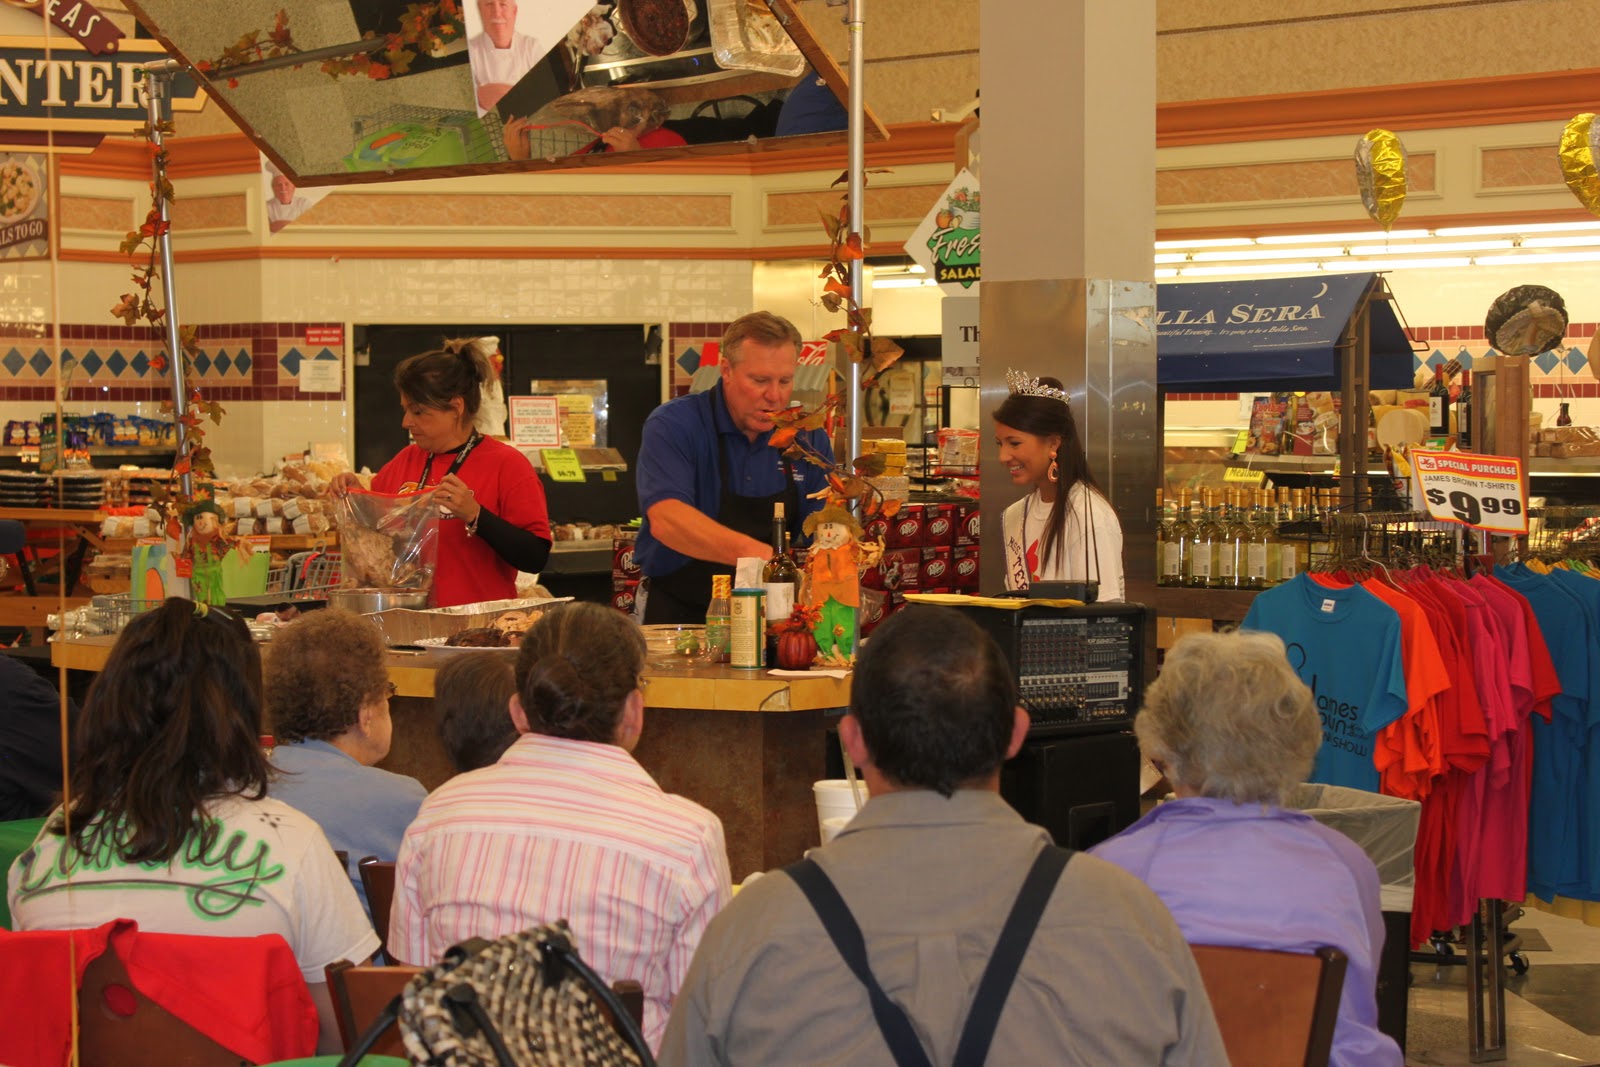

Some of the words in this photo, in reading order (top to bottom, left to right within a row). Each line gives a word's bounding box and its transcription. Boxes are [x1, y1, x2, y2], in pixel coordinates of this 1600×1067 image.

[0, 227, 14, 245] LS
[15, 223, 28, 240] TO
[29, 220, 43, 236] GO
[931, 227, 980, 264] Fres
[1157, 309, 1217, 325] LLA
[1225, 303, 1324, 324] SERA
[1268, 325, 1289, 333] Bella
[1437, 459, 1470, 471] SPECIAL
[1471, 464, 1517, 476] PURCHASE
[1424, 475, 1451, 483] JAMES
[1452, 476, 1478, 488] BROWN
[1480, 481, 1516, 491] T-SHIRTS
